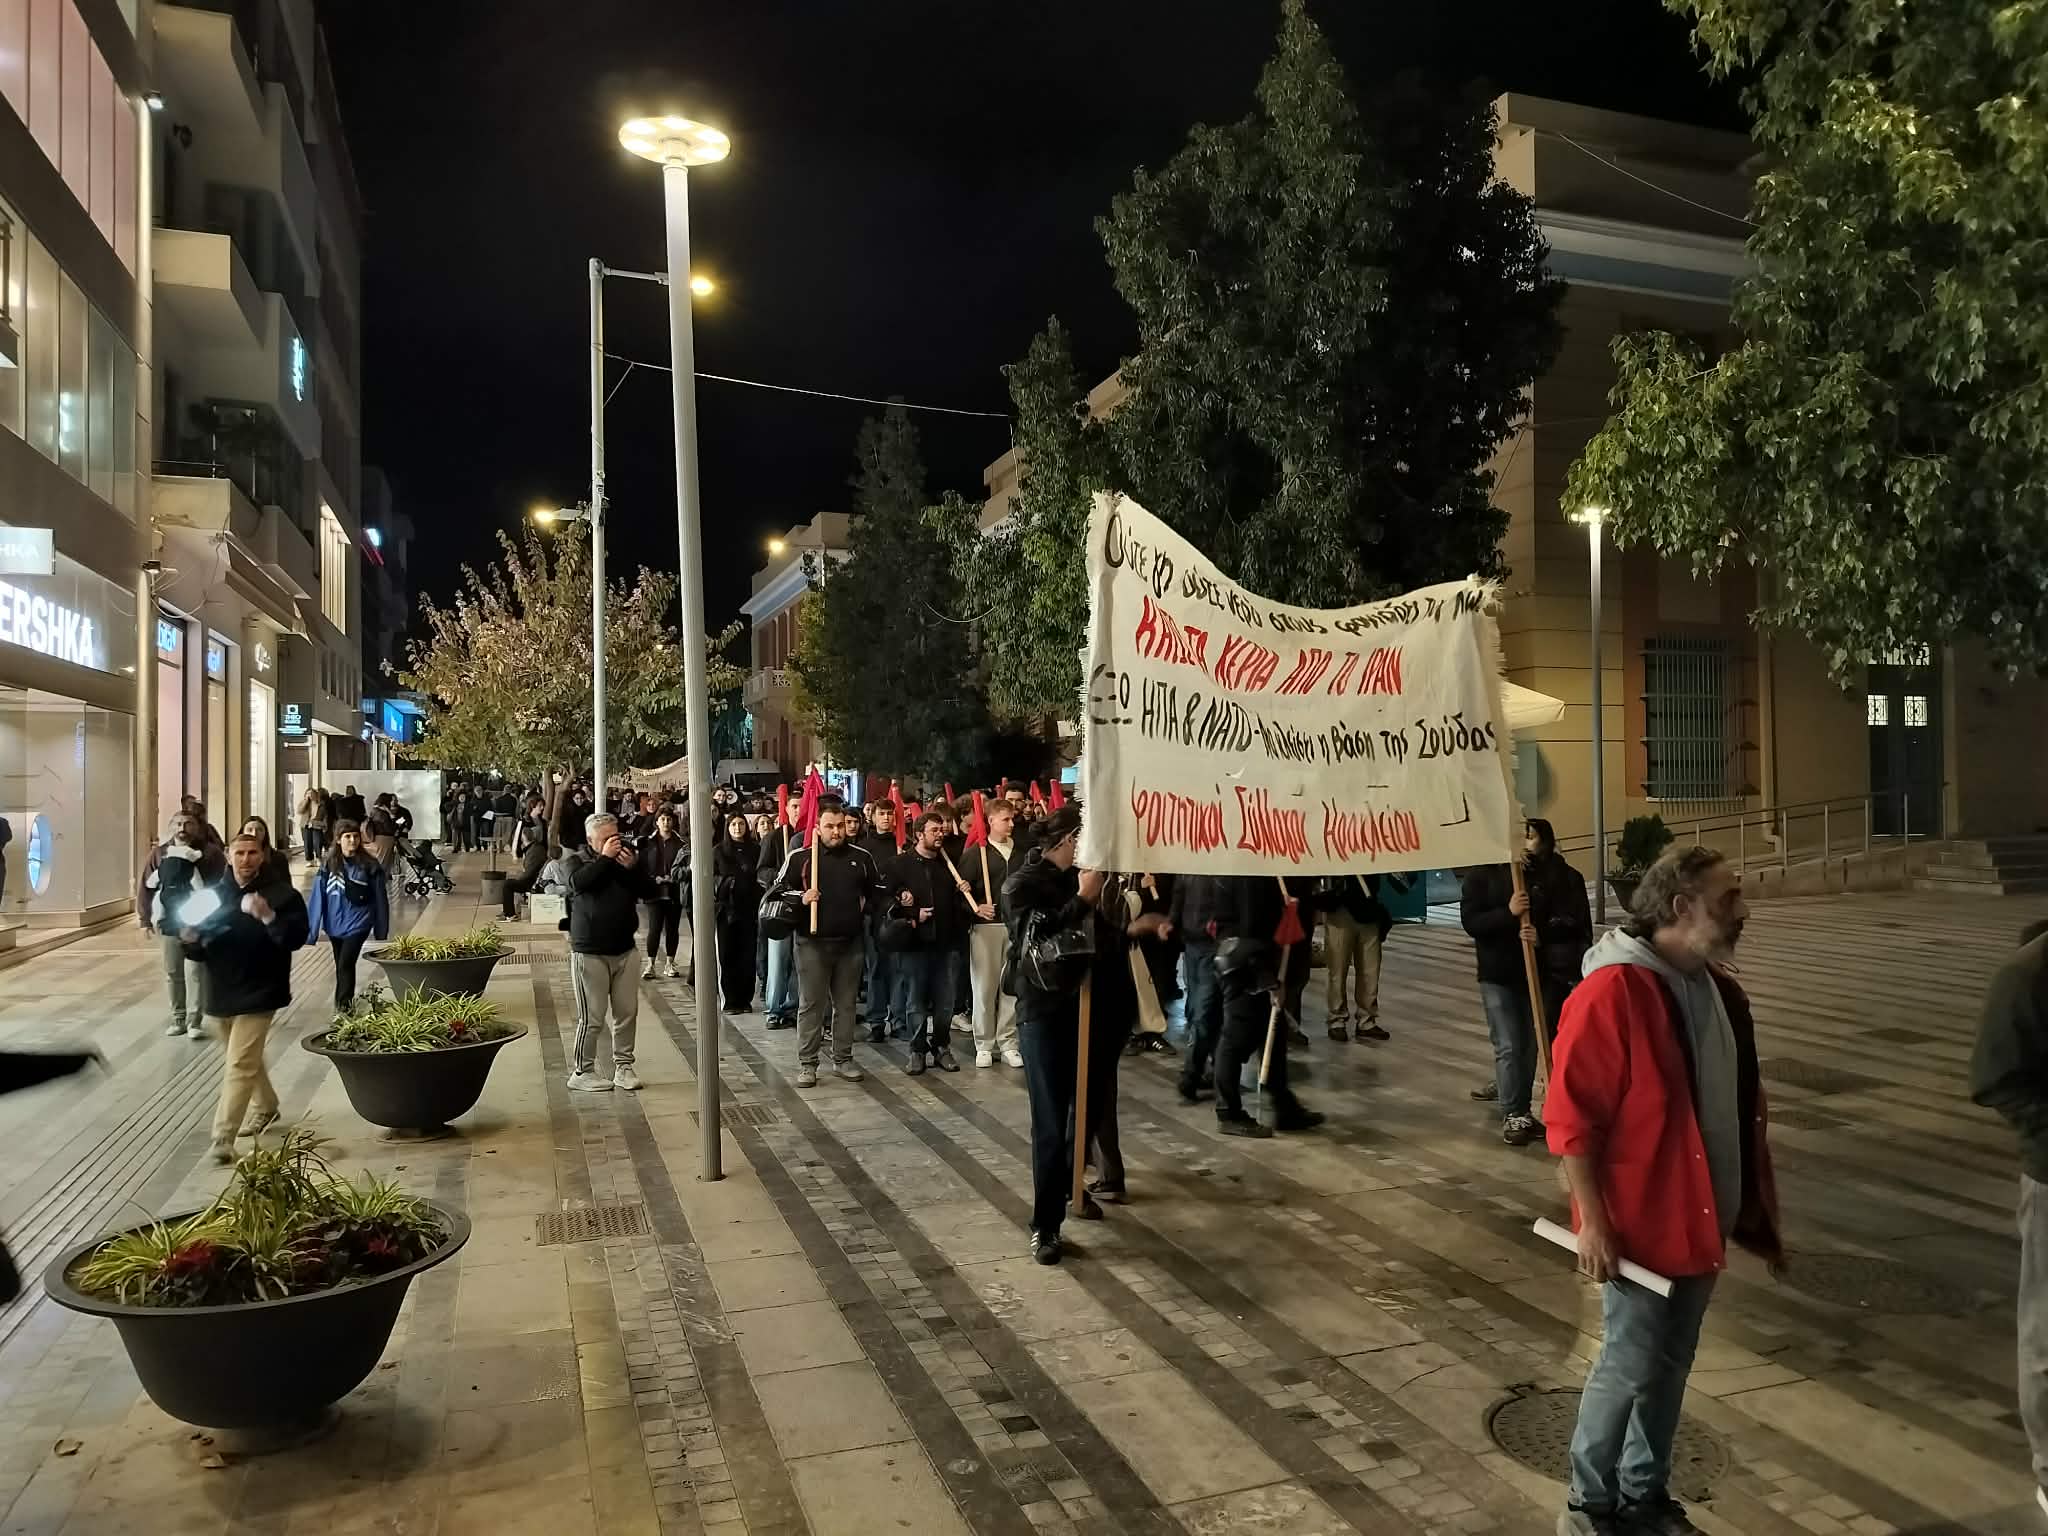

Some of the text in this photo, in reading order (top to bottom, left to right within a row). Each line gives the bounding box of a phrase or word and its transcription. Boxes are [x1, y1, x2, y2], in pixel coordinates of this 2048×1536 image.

[0, 580, 94, 666] ERSHKA
[1275, 648, 1333, 695] ΑΠΟ
[1327, 651, 1360, 695] ΤΟ
[1356, 645, 1403, 695] ΙΡΑΝ
[1142, 677, 1179, 744] ΗΠΑ
[1182, 692, 1201, 745] &
[1317, 733, 1330, 766] η
[1379, 730, 1409, 764] της
